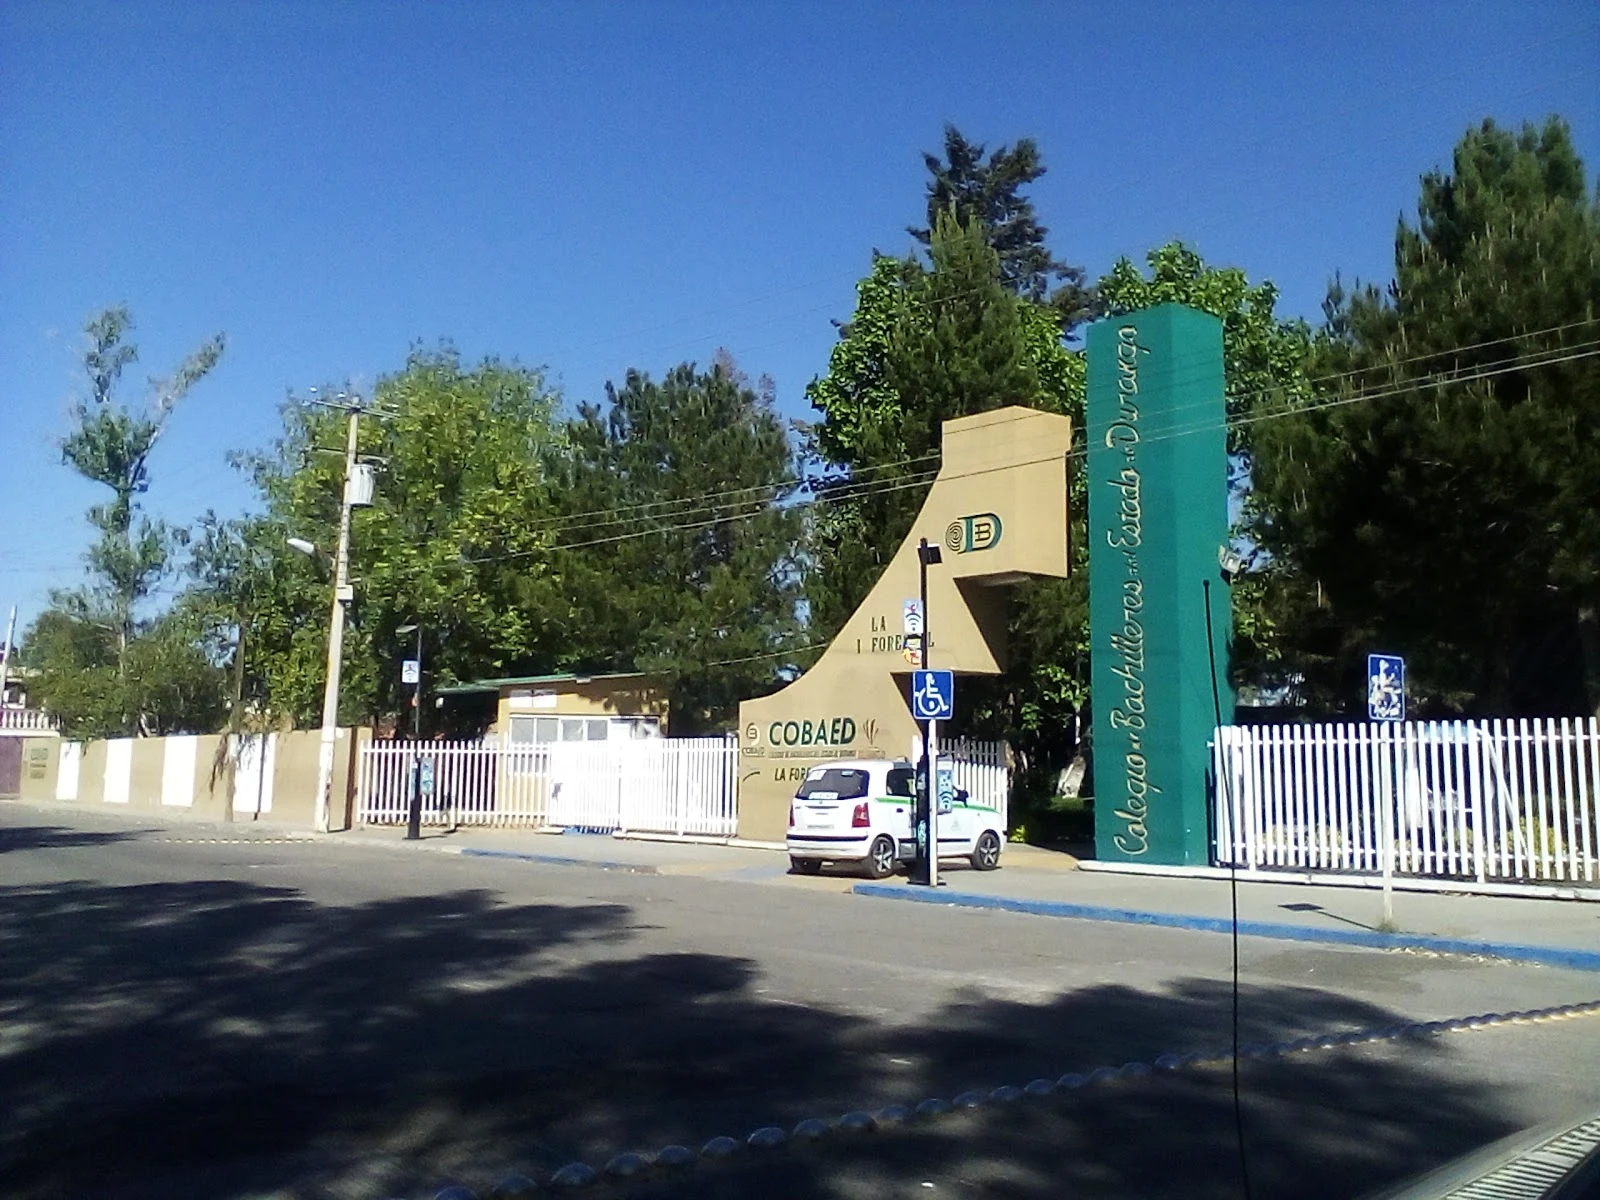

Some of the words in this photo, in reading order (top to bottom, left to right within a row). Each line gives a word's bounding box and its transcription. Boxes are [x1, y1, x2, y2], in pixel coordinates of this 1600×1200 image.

[1105, 324, 1150, 449] Durango
[1106, 466, 1141, 548] Estado
[871, 615, 886, 632] LA
[871, 631, 935, 653] FOREL
[1110, 578, 1147, 731] Bachilleres
[768, 717, 857, 747] COBAED
[774, 767, 786, 781] LA
[1113, 752, 1162, 856] Colegio
